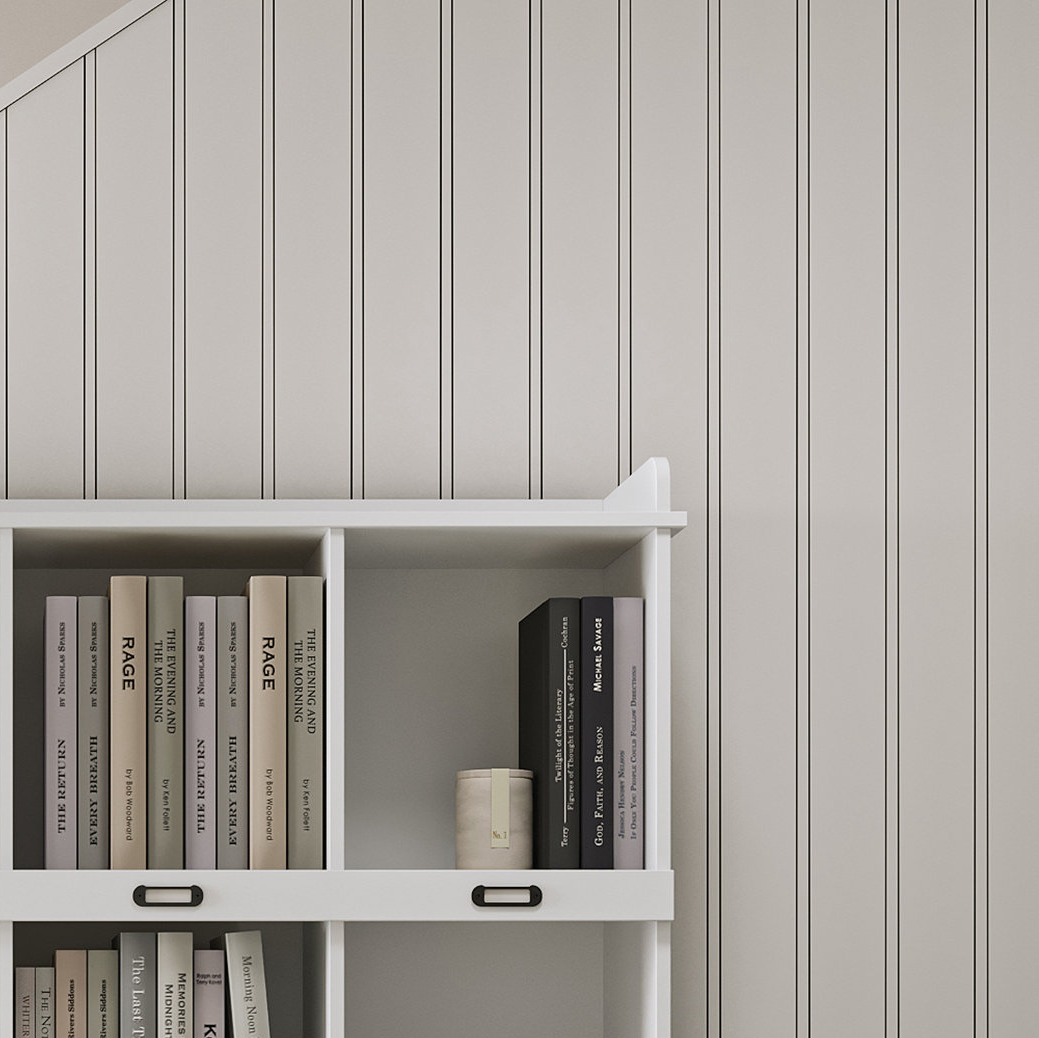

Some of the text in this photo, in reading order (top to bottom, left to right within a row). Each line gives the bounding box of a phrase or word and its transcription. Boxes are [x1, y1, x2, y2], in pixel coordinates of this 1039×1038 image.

[123, 638, 135, 690] RAGE
[154, 641, 164, 722] THE MORNING
[167, 629, 176, 733] THE EVENING AND
[125, 769, 132, 779] by
[162, 779, 169, 788] by
[197, 740, 205, 799] RETURN
[132, 957, 145, 984] The
[132, 990, 144, 1022] Last
